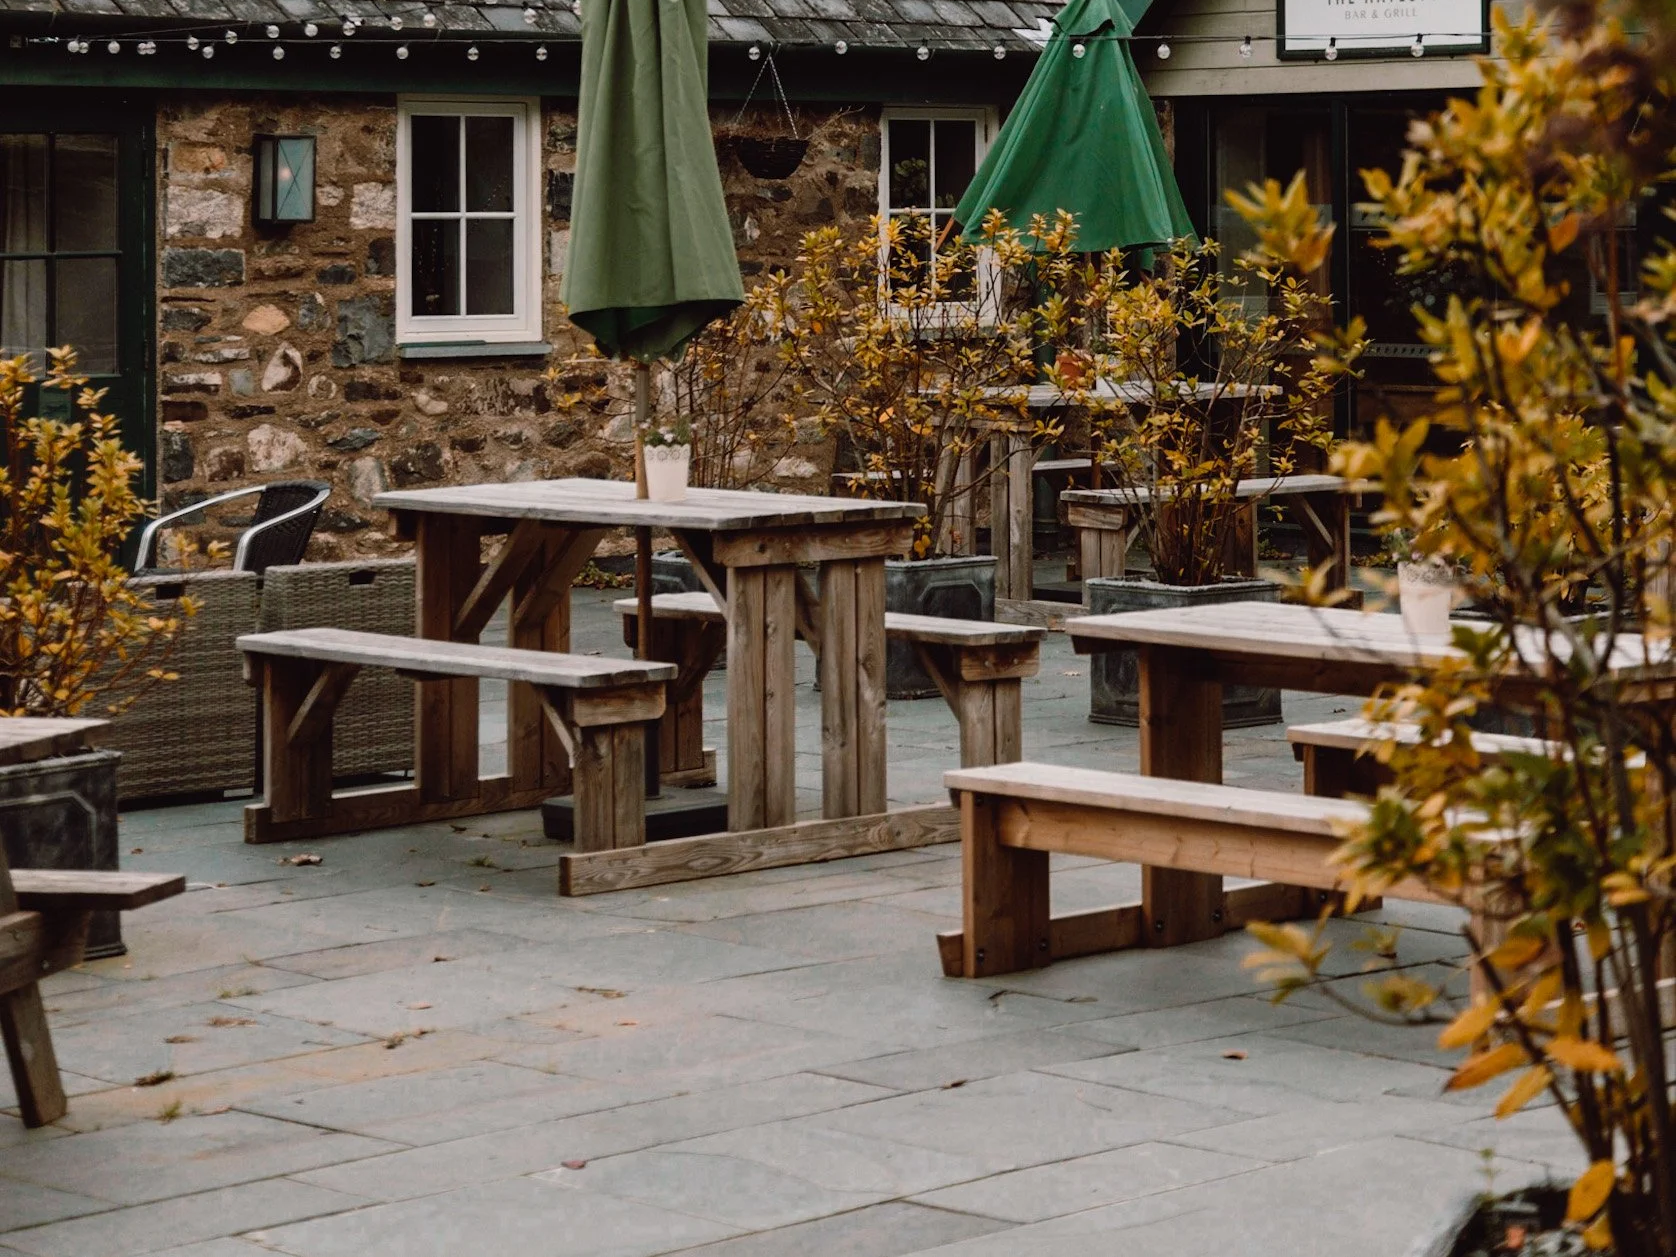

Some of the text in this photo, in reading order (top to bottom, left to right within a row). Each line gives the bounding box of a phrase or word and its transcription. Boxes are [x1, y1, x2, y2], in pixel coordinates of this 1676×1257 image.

[1344, 7, 1418, 20] BAR & GRILL
